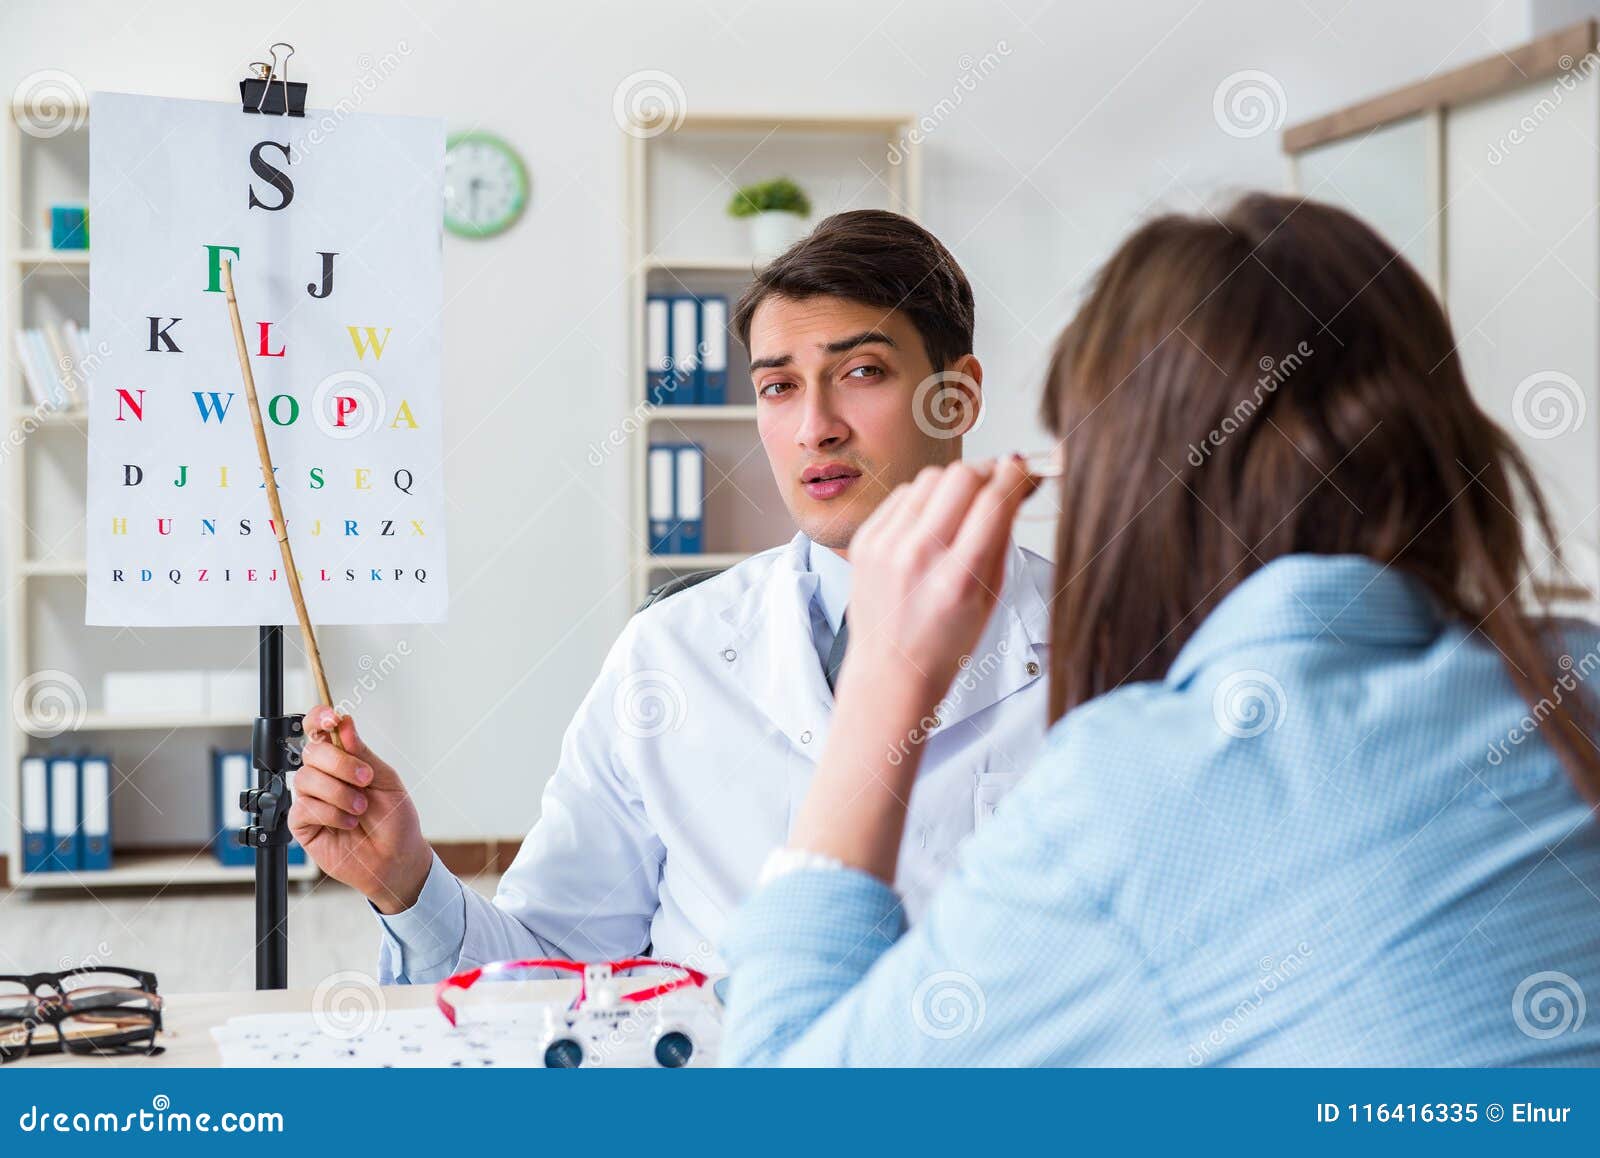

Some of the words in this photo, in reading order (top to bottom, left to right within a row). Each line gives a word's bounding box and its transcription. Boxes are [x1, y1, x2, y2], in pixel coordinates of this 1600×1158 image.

[248, 140, 295, 211] S
[306, 251, 340, 299] J
[145, 316, 184, 353] K
[255, 321, 287, 358] L
[346, 326, 393, 361] W
[115, 388, 146, 422] N
[191, 391, 235, 424] W
[267, 393, 301, 427] O
[332, 396, 358, 427] P
[390, 399, 420, 430] A
[122, 464, 144, 487] D
[173, 465, 189, 488] J
[219, 466, 229, 488] I
[309, 467, 326, 490] S
[354, 468, 372, 490] E
[393, 469, 413, 496] Q
[112, 517, 128, 535] H
[157, 518, 173, 536] U
[201, 519, 217, 536] N
[239, 519, 252, 536] S
[311, 519, 322, 536] J
[344, 520, 360, 536] R
[380, 520, 395, 537] Z
[410, 520, 426, 537] X
[112, 569, 125, 582] R
[140, 569, 153, 582] D
[168, 569, 182, 585] Q
[198, 569, 209, 582] Z
[225, 569, 231, 582] I
[247, 569, 258, 582] E
[269, 569, 278, 582] J
[320, 569, 331, 581] L
[345, 569, 355, 582] S
[370, 569, 383, 582] K
[394, 569, 404, 582] P
[414, 569, 427, 584] Q
